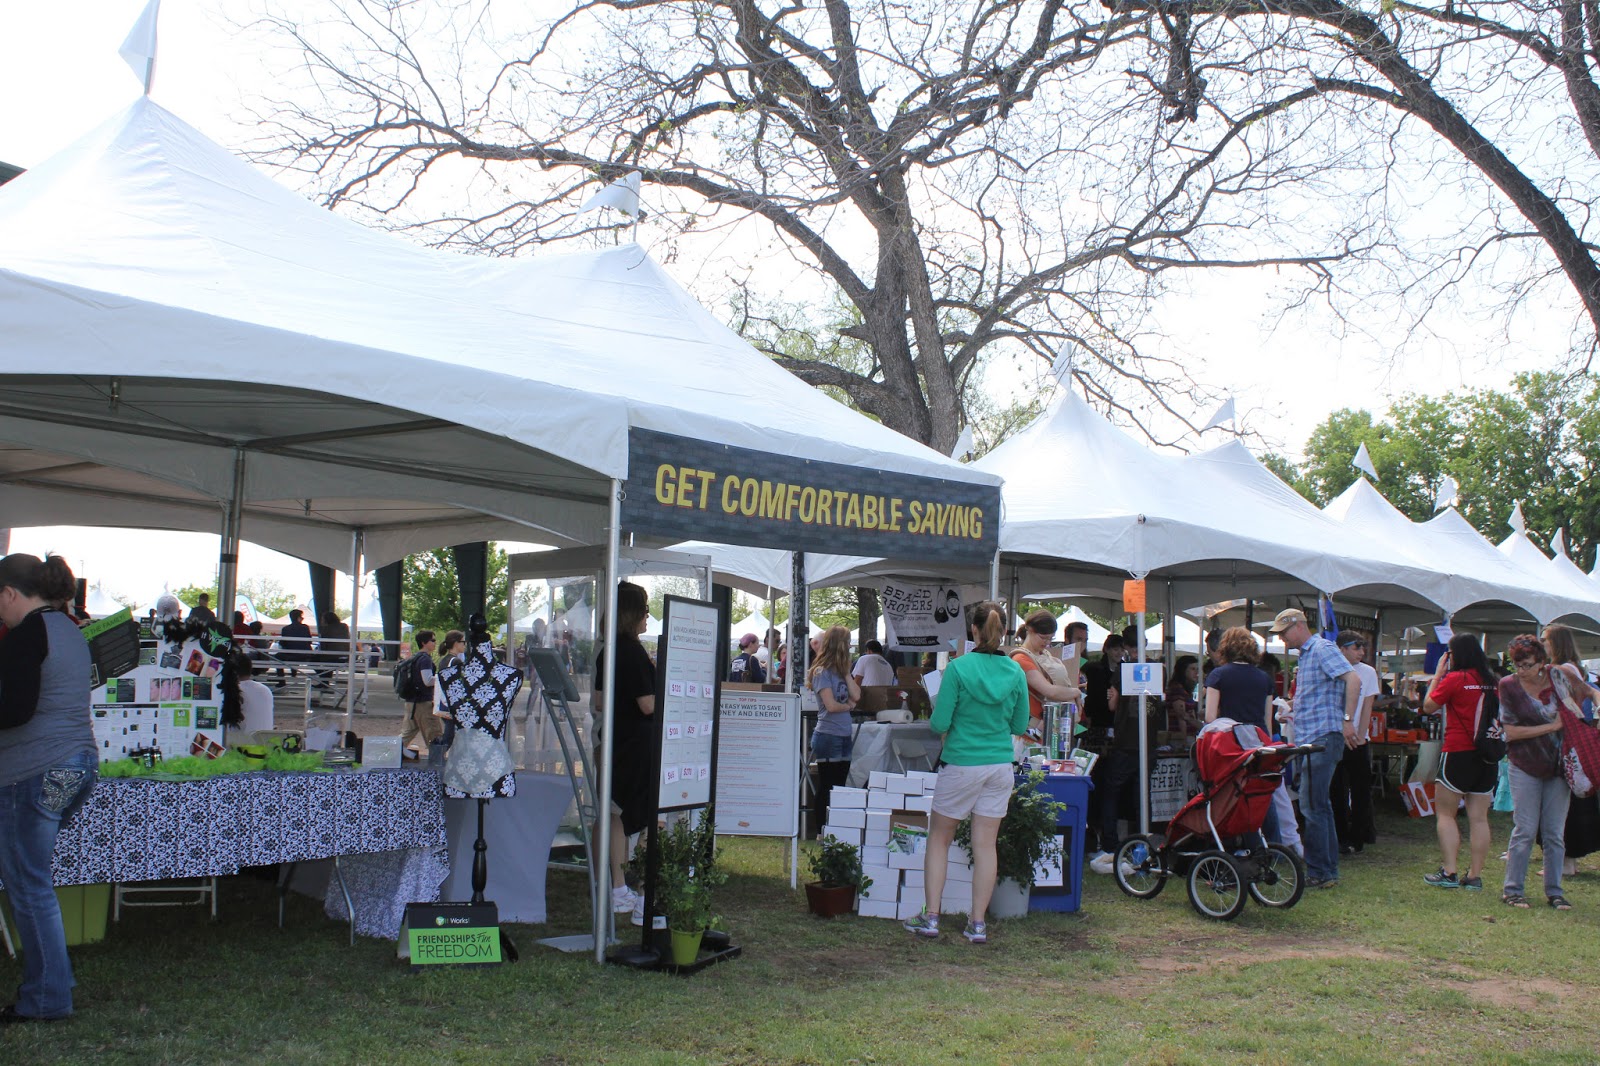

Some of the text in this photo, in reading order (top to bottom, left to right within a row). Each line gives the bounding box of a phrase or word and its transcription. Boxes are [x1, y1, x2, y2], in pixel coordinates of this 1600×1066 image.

[655, 463, 983, 540] GET COMFORTABLE SAVING
[1151, 776, 1184, 789] THERS
[417, 931, 492, 944] FRIENDSHIPS Fun
[418, 943, 493, 958] FREEDOM
